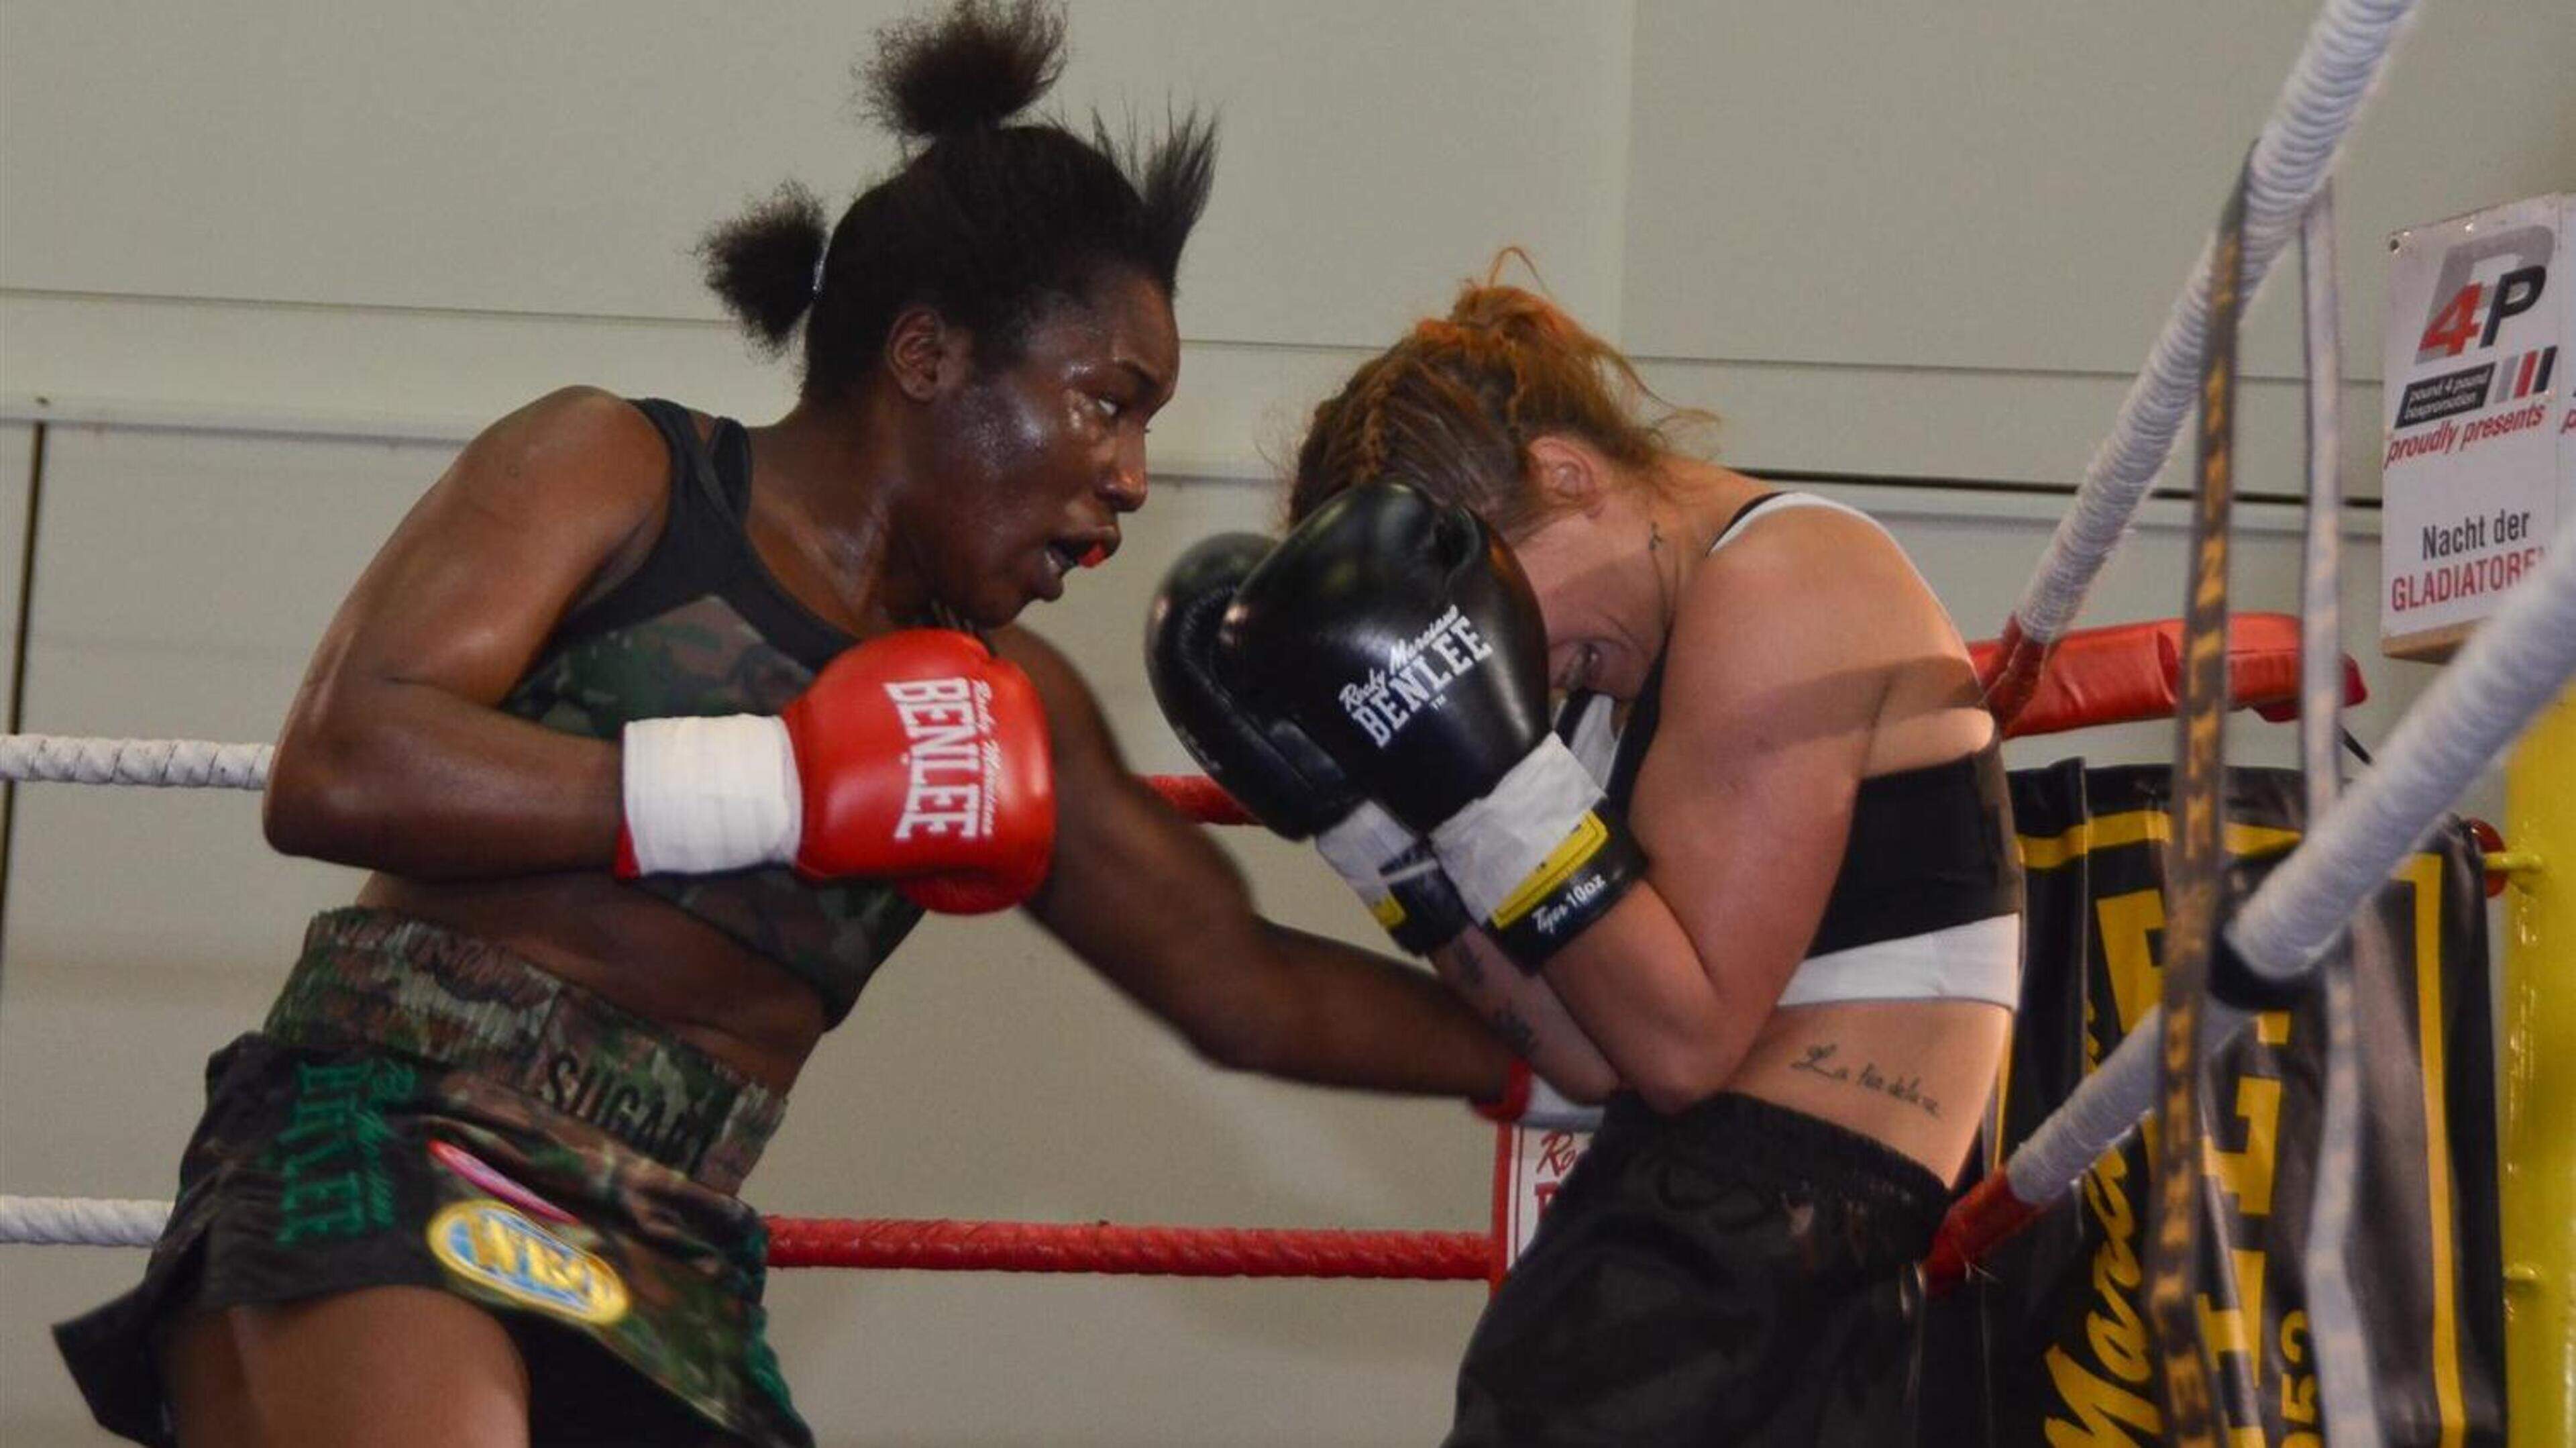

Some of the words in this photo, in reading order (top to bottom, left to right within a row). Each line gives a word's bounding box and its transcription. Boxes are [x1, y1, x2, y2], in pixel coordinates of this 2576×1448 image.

[2385, 420, 2459, 469] proudly
[2461, 404, 2546, 452] presents
[2422, 515, 2485, 560] Nacht
[2493, 508, 2530, 544] der
[1339, 668, 1390, 713] Rocky
[1351, 615, 1494, 748] BENLEE
[881, 676, 981, 841] BENLEE
[1566, 873, 1607, 909] 10oz
